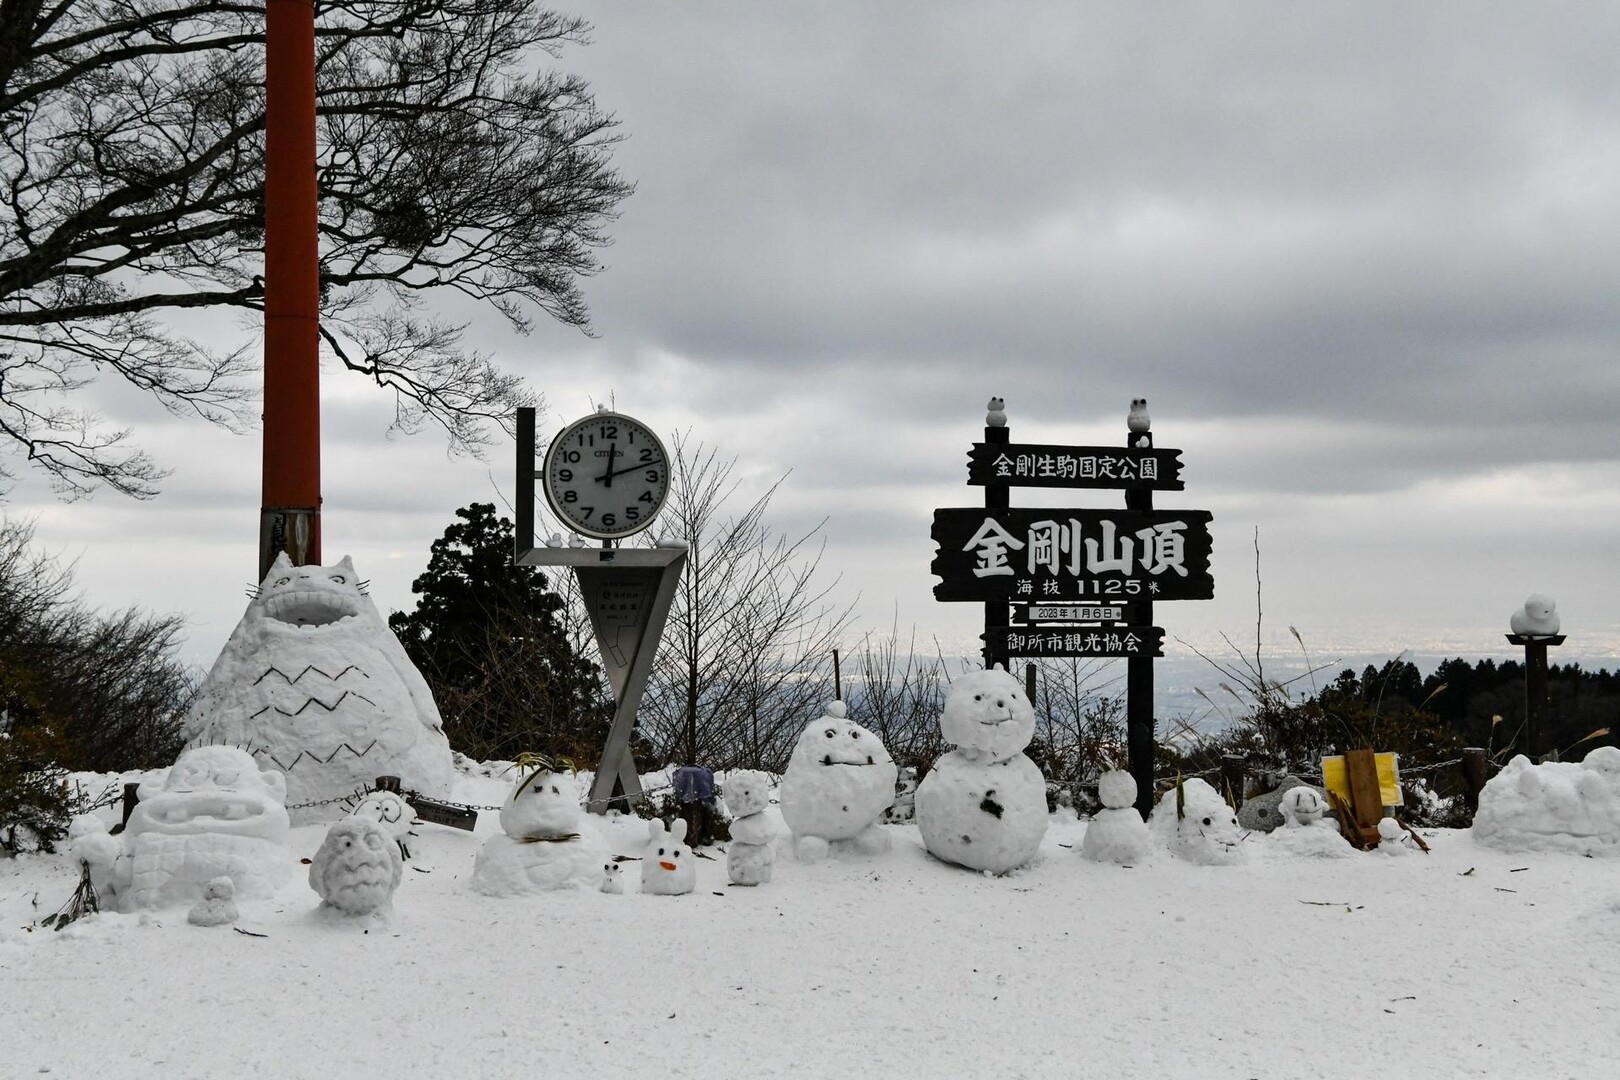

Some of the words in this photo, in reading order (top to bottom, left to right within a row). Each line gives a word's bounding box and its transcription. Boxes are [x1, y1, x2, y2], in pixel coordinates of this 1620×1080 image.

[601, 426, 617, 439] 12
[628, 432, 634, 444] 1
[579, 434, 593, 446] 11
[563, 451, 580, 463] 10
[640, 449, 652, 461] 2
[992, 453, 1157, 480] 金剛生駒国定公園
[559, 469, 572, 481] 9
[646, 470, 658, 482] 3
[564, 491, 577, 503] 8
[639, 491, 653, 503] 4
[581, 507, 594, 519] 7
[626, 507, 639, 519] 5
[602, 514, 615, 526] 6
[962, 517, 1188, 578] 金剛山頂
[1007, 632, 1142, 652] 御所市観光協会
